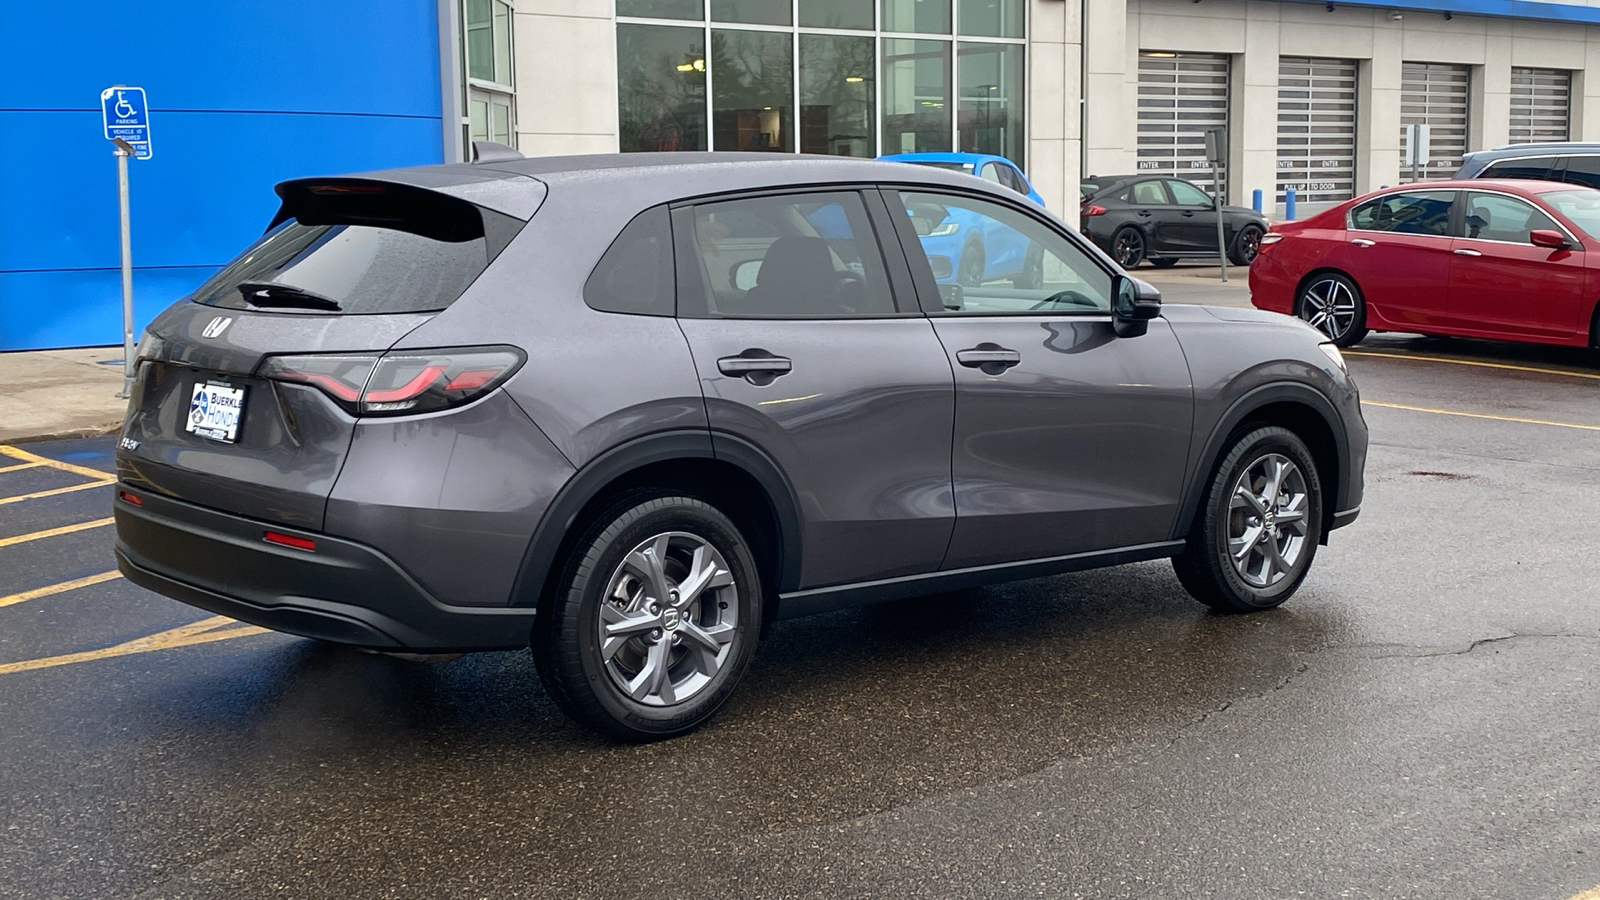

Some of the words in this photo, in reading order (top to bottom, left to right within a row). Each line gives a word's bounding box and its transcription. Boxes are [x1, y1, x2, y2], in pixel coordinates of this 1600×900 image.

[1139, 161, 1159, 169] ENTER
[1190, 161, 1210, 169] ENTER
[1322, 160, 1339, 168] ENTER
[1284, 183, 1297, 191] PULL
[211, 392, 242, 408] BUERKLE
[207, 405, 240, 427] HONDA
